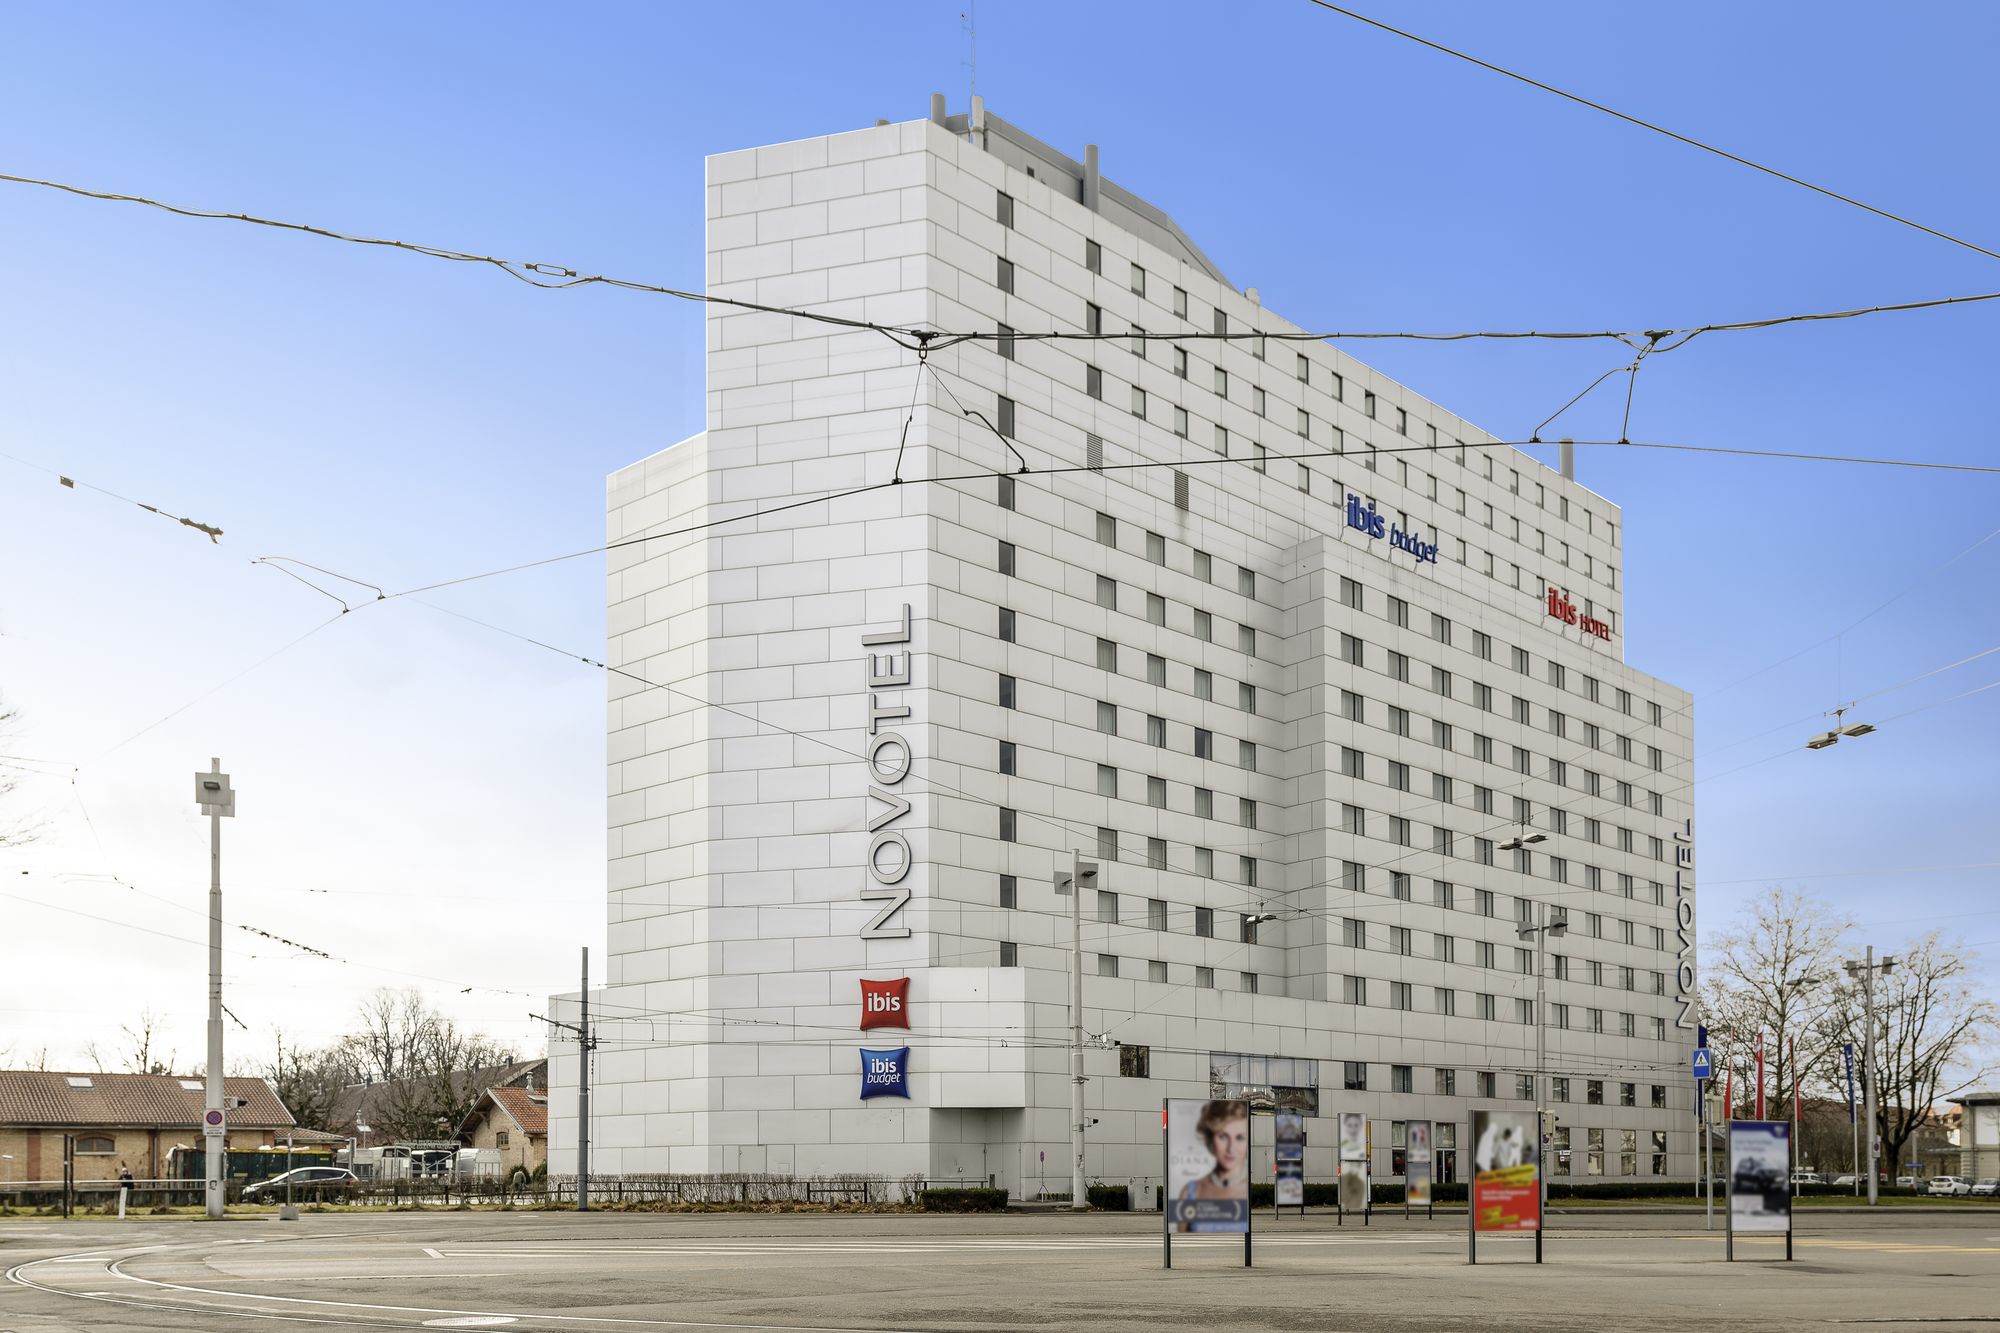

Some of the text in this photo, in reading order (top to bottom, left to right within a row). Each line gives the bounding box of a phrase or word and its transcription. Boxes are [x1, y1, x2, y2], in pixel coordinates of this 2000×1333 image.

[1347, 493, 1439, 564] ibis budget
[1548, 586, 1612, 642] ibis HOTEL
[860, 603, 911, 939] NOVOTEL
[1674, 818, 1695, 1029] NOVOTEL
[867, 992, 901, 1012] ibis
[867, 1072, 902, 1086] budget
[871, 1058, 897, 1073] ibis
